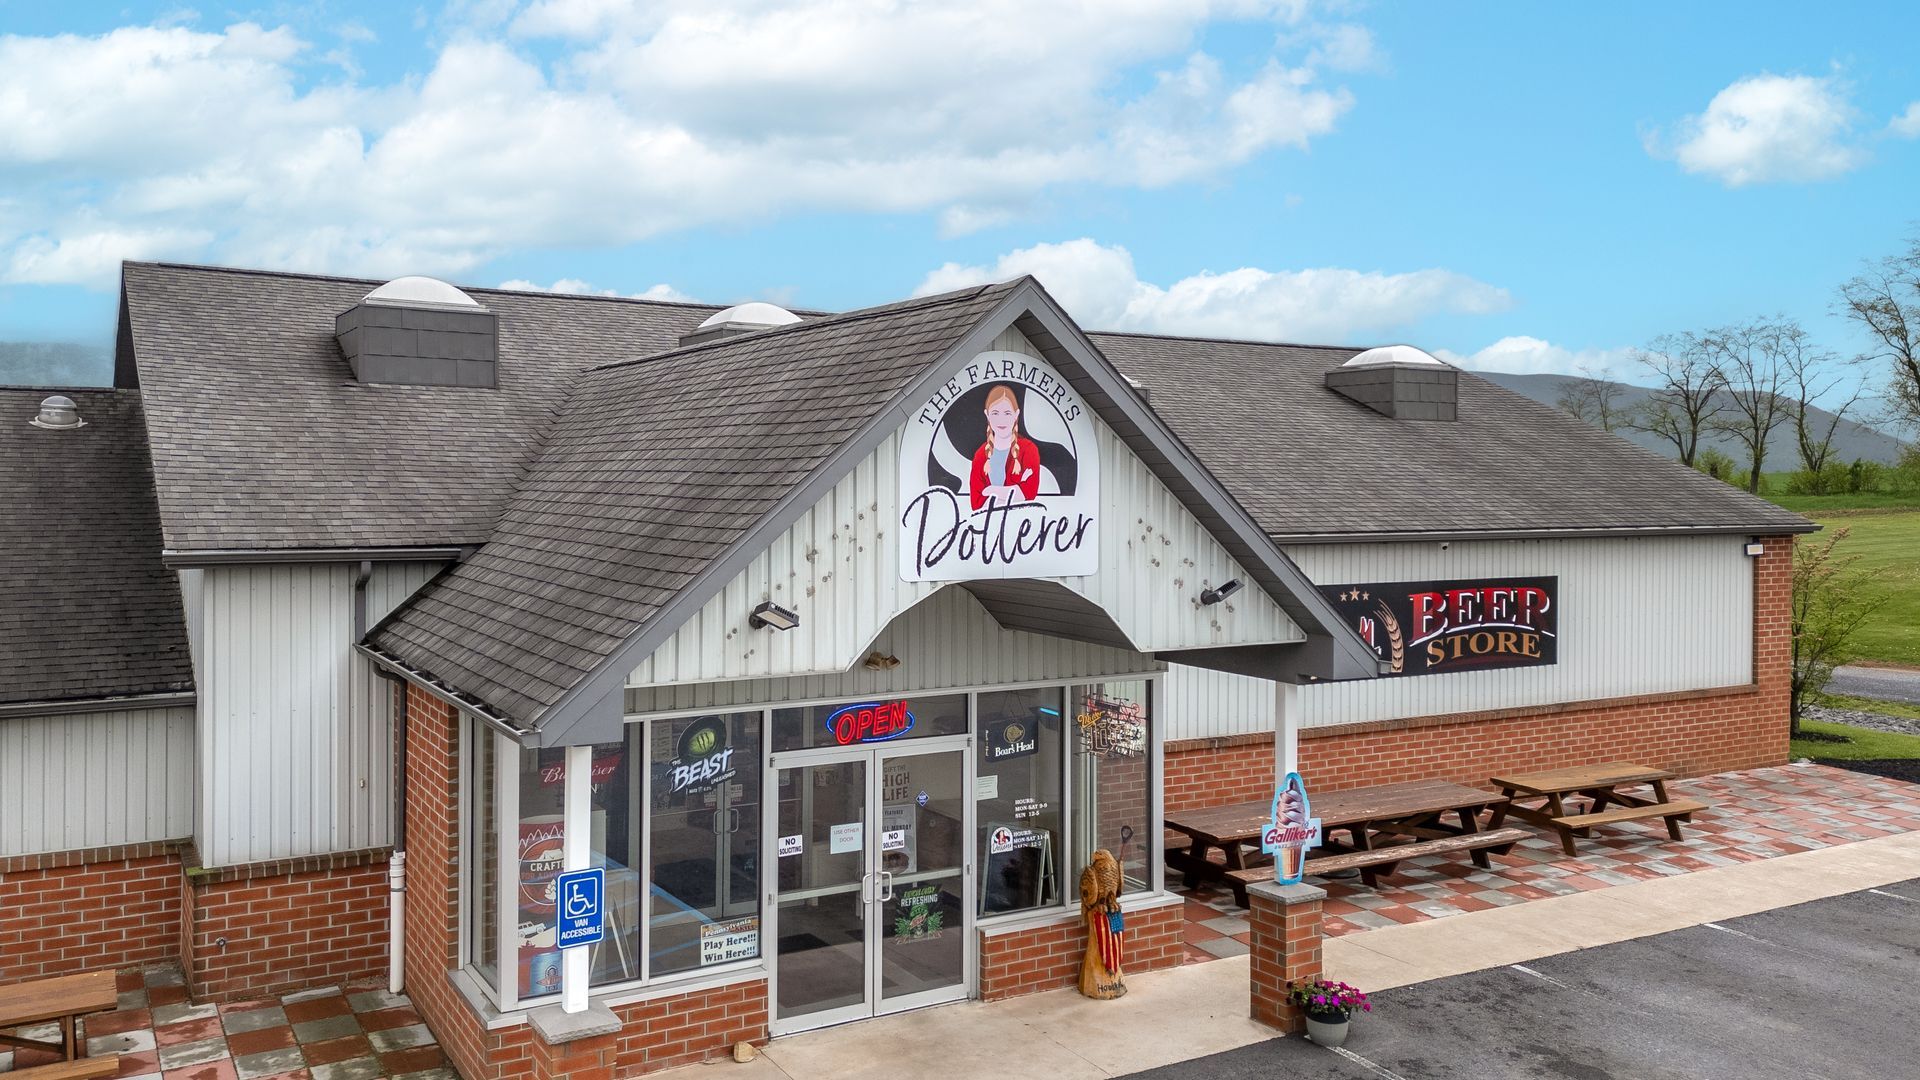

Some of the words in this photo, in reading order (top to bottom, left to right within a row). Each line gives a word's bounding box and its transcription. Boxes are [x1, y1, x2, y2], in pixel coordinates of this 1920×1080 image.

[919, 378, 962, 427] THE
[965, 360, 1081, 422] FARMER'S
[902, 489, 1094, 578] Dotterer
[1408, 587, 1553, 645] BEER
[1426, 631, 1541, 667] STORE
[836, 700, 907, 744] OPEN
[995, 743, 1015, 757] Boar's
[1016, 739, 1034, 753] Head
[541, 765, 615, 782] Buiser
[672, 749, 733, 792] BEAST
[882, 786, 908, 801] LIFE
[785, 837, 796, 846] NO
[888, 832, 899, 840] NO
[1264, 826, 1318, 845] Galliker's
[779, 846, 801, 856] SOLICITING
[883, 840, 904, 849] SOLICITING
[530, 861, 565, 872] CRAFT
[900, 894, 938, 907] REFRESHING
[574, 918, 589, 928] VAN
[561, 925, 601, 940] ACCESSIBLE
[704, 940, 724, 950] Play
[726, 933, 756, 946] Here!!!
[704, 953, 723, 963] Win
[725, 946, 755, 959] Here!!!
